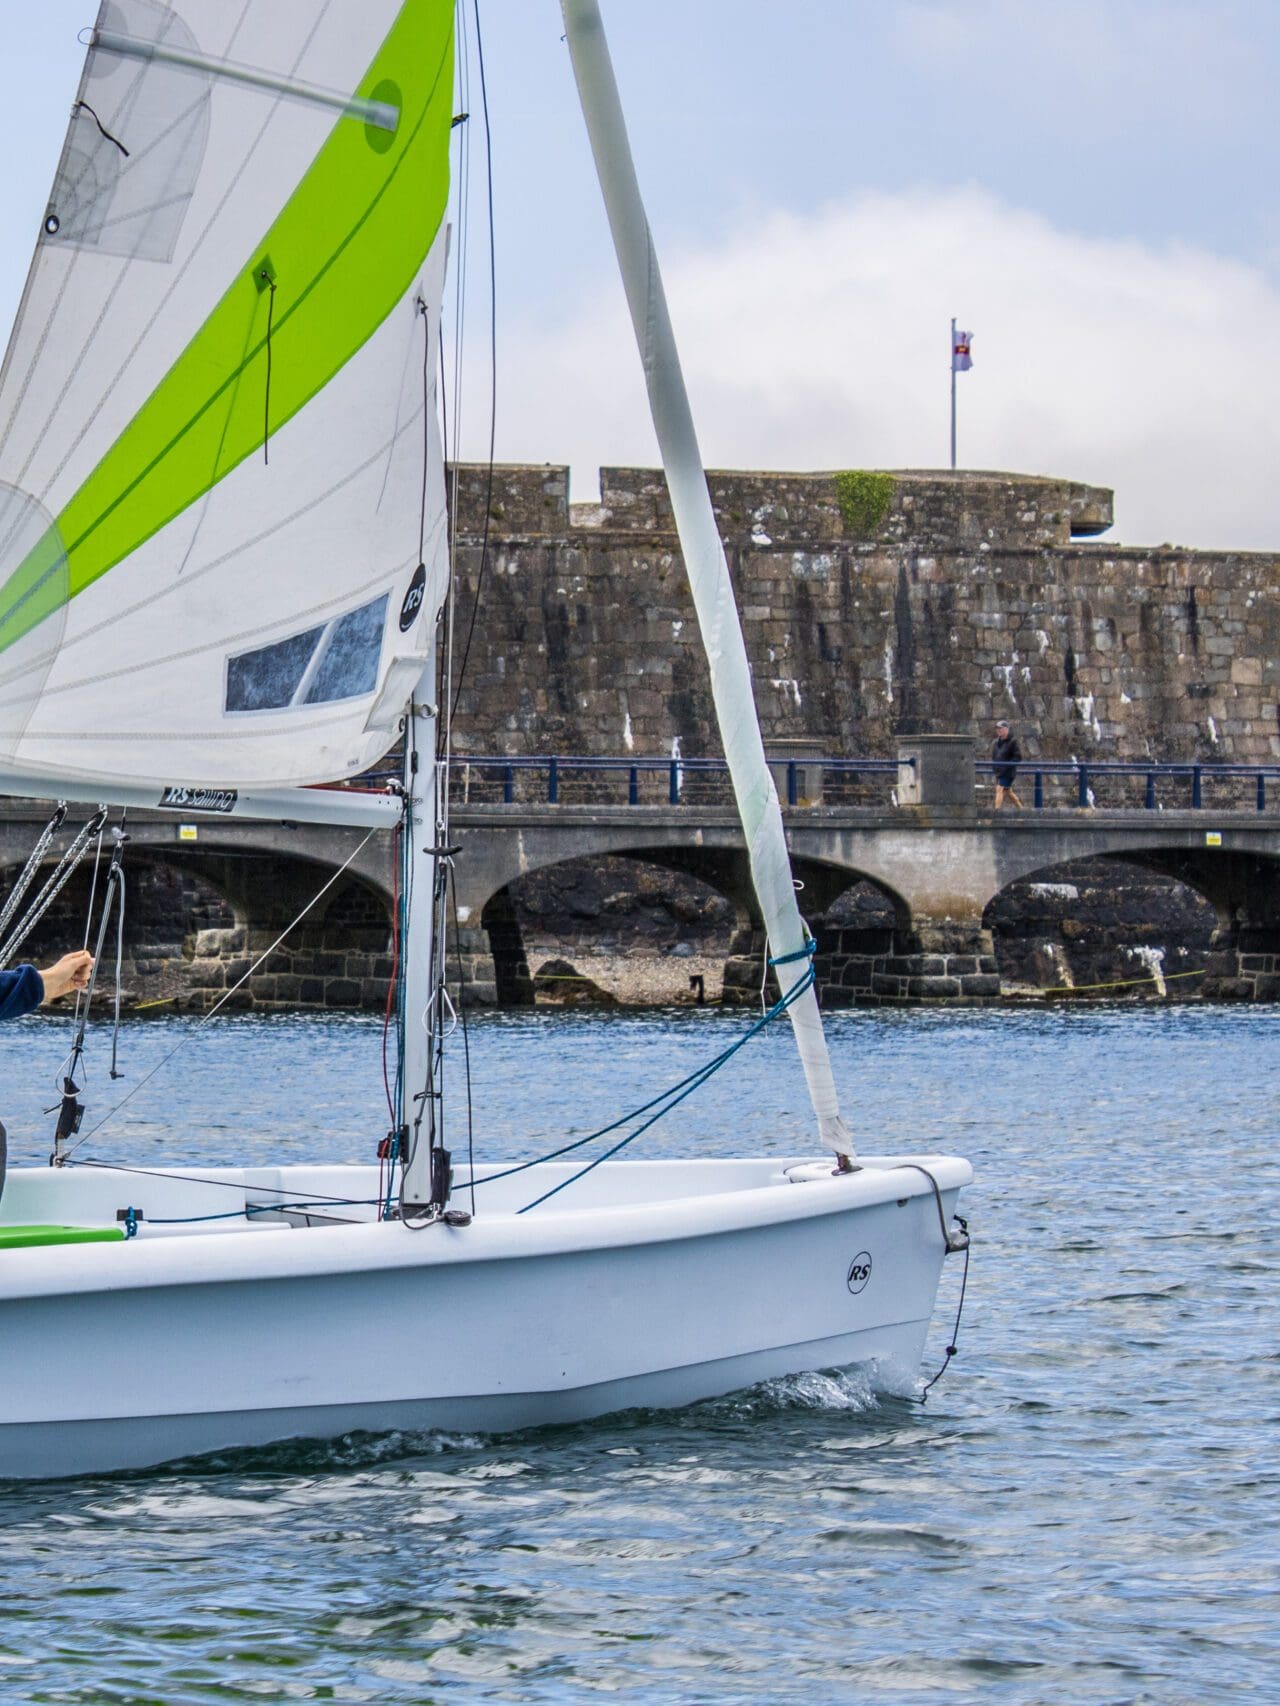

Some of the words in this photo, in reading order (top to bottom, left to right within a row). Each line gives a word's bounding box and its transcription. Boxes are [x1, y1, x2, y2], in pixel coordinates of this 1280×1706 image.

[403, 582, 425, 614] RS
[165, 787, 191, 803] RS
[187, 788, 234, 811] sailing
[848, 1263, 871, 1282] RS
